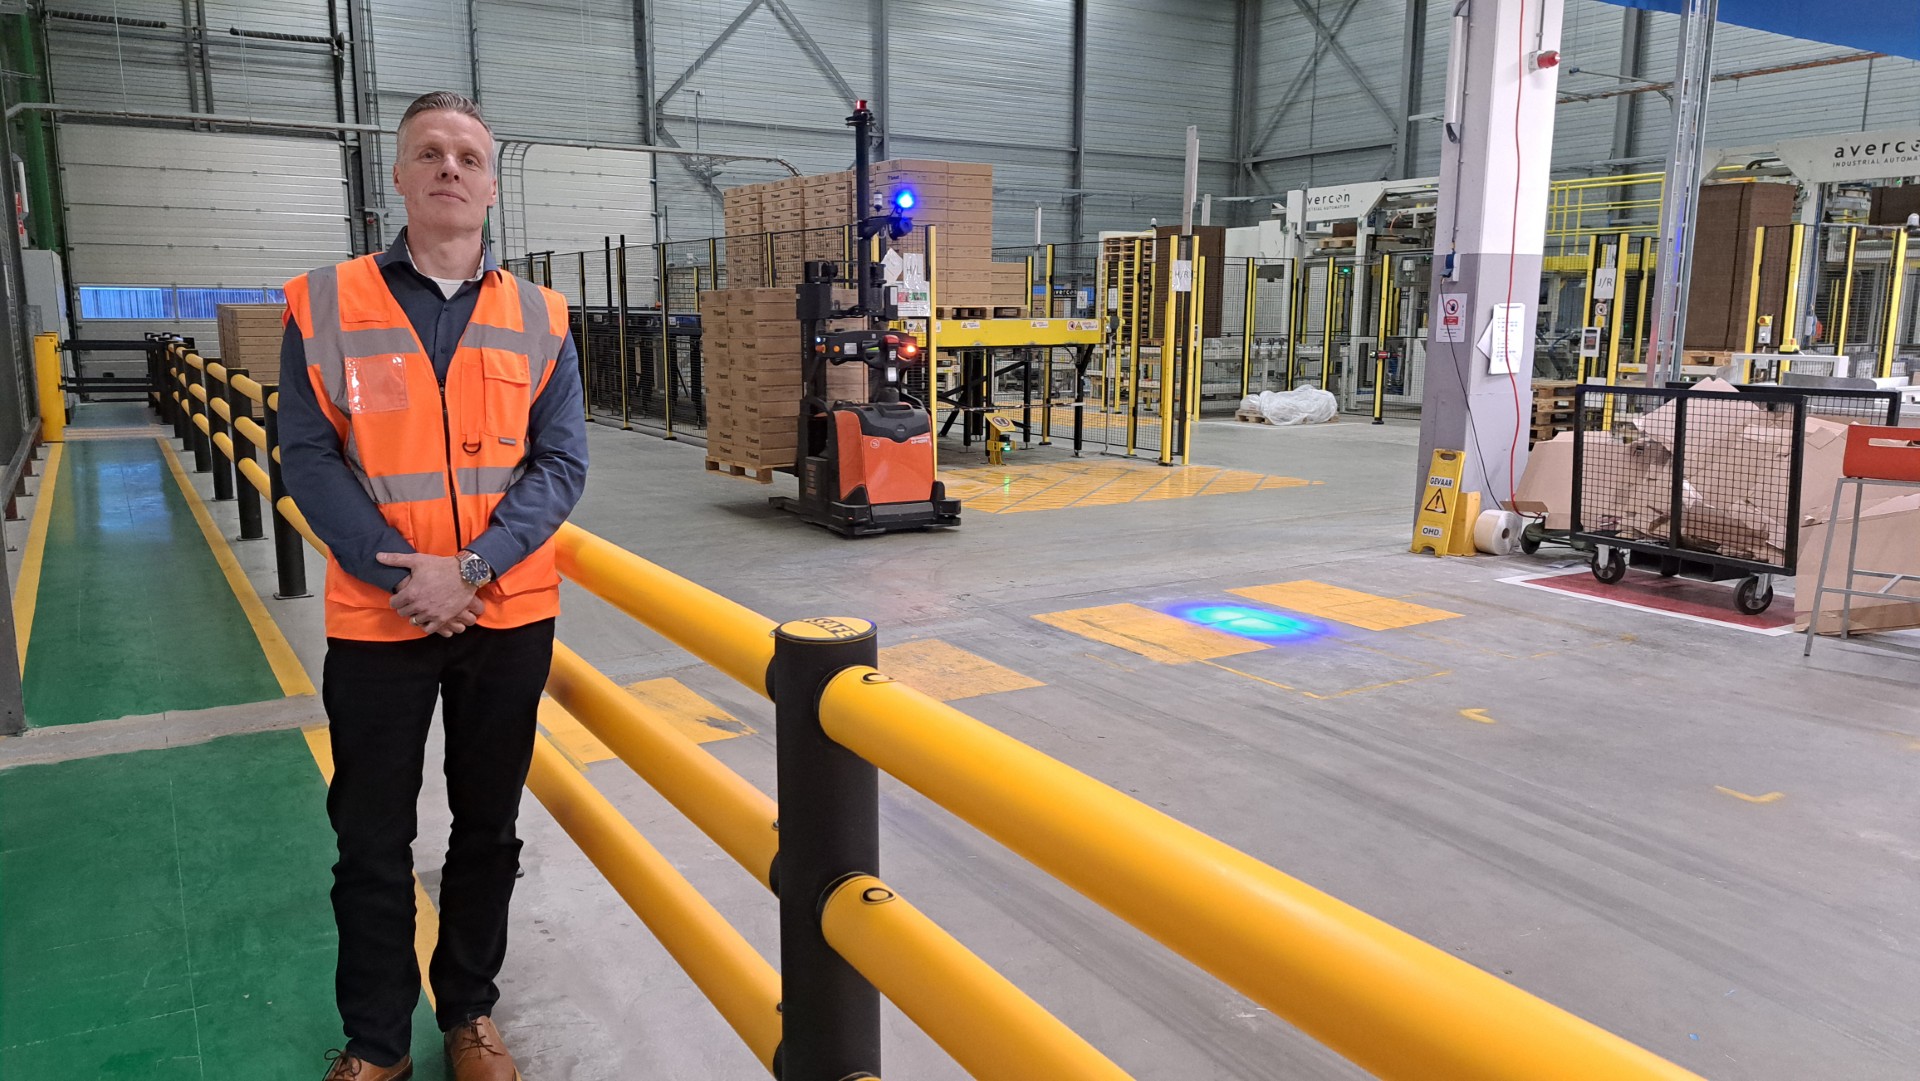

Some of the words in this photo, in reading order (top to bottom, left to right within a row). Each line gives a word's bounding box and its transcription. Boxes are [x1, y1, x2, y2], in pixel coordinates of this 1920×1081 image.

[1834, 140, 1920, 158] averco
[1833, 159, 1880, 168] INDUSTRIAL
[1307, 193, 1350, 205] vercon
[1429, 476, 1453, 488] GEVAAR
[1422, 527, 1441, 537] OHD.
